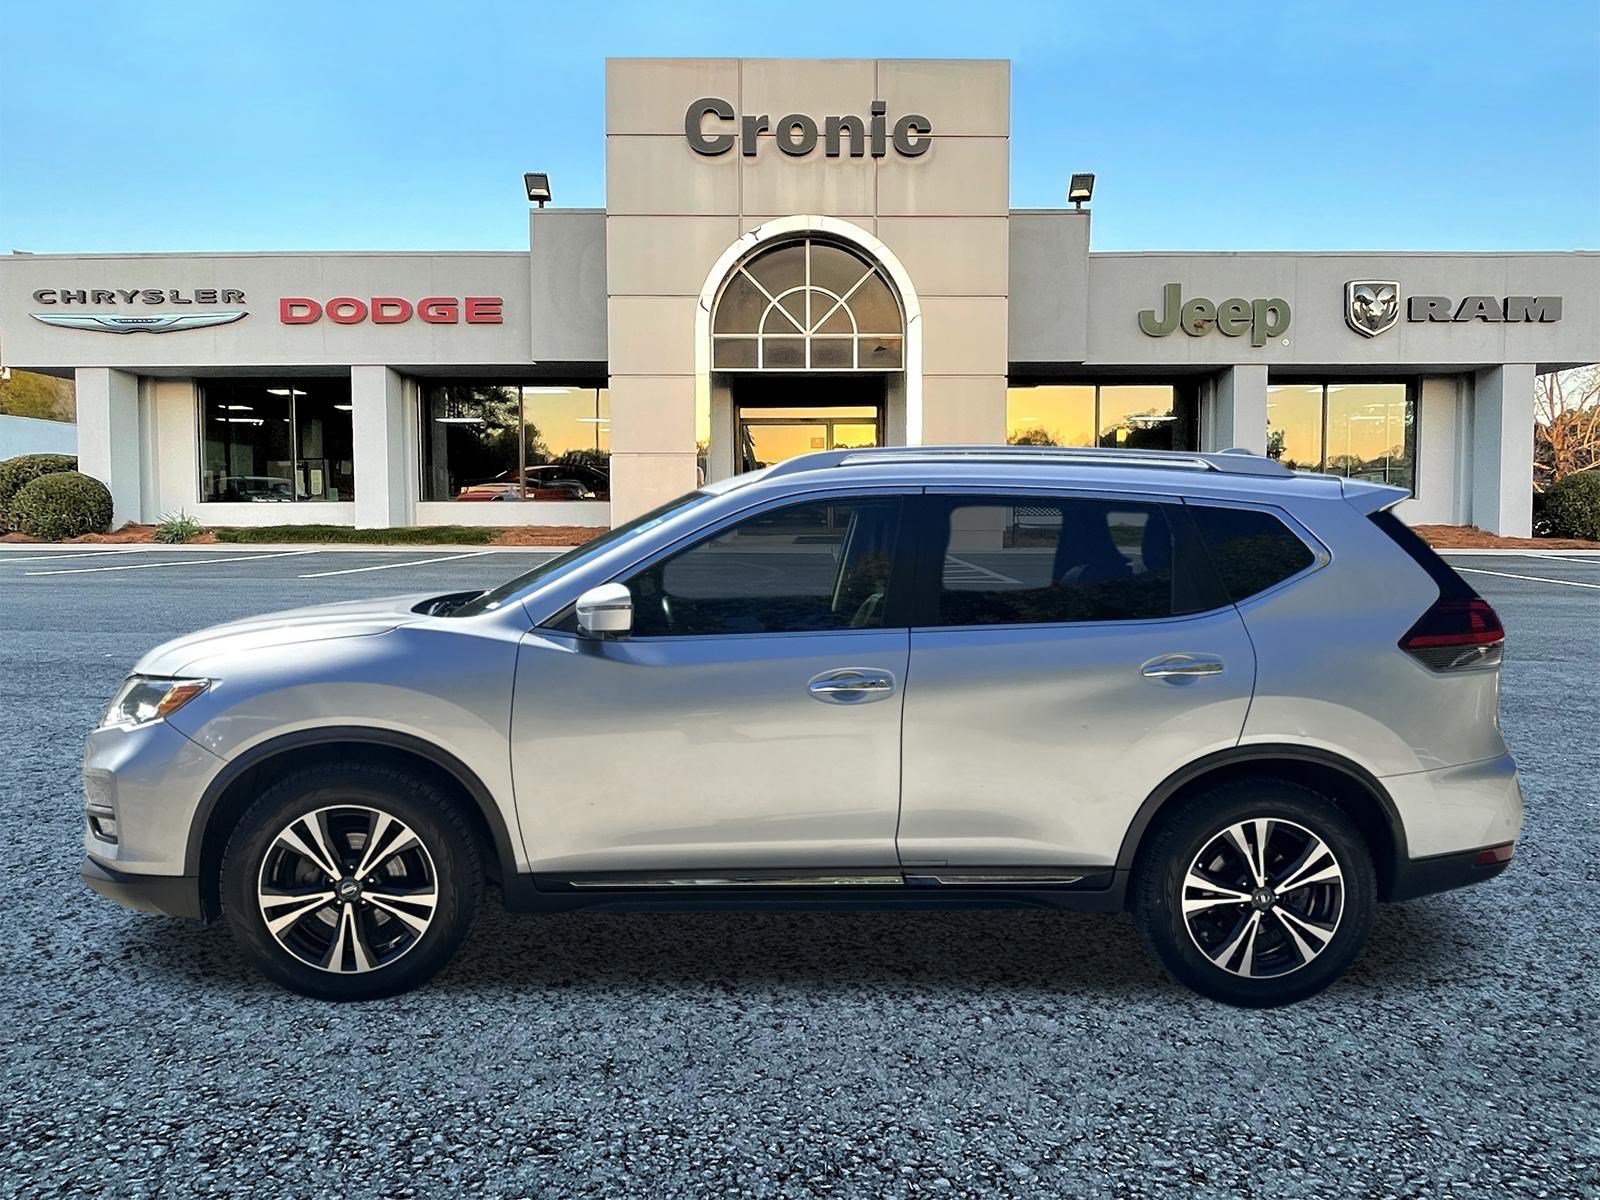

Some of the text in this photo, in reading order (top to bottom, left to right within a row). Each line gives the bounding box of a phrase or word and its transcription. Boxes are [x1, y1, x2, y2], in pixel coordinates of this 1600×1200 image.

[685, 98, 932, 157] Cronic
[32, 289, 246, 304] CHRYSLER
[1407, 296, 1563, 322] RAM
[280, 297, 503, 324] DODGE
[1138, 283, 1291, 347] Jeep
